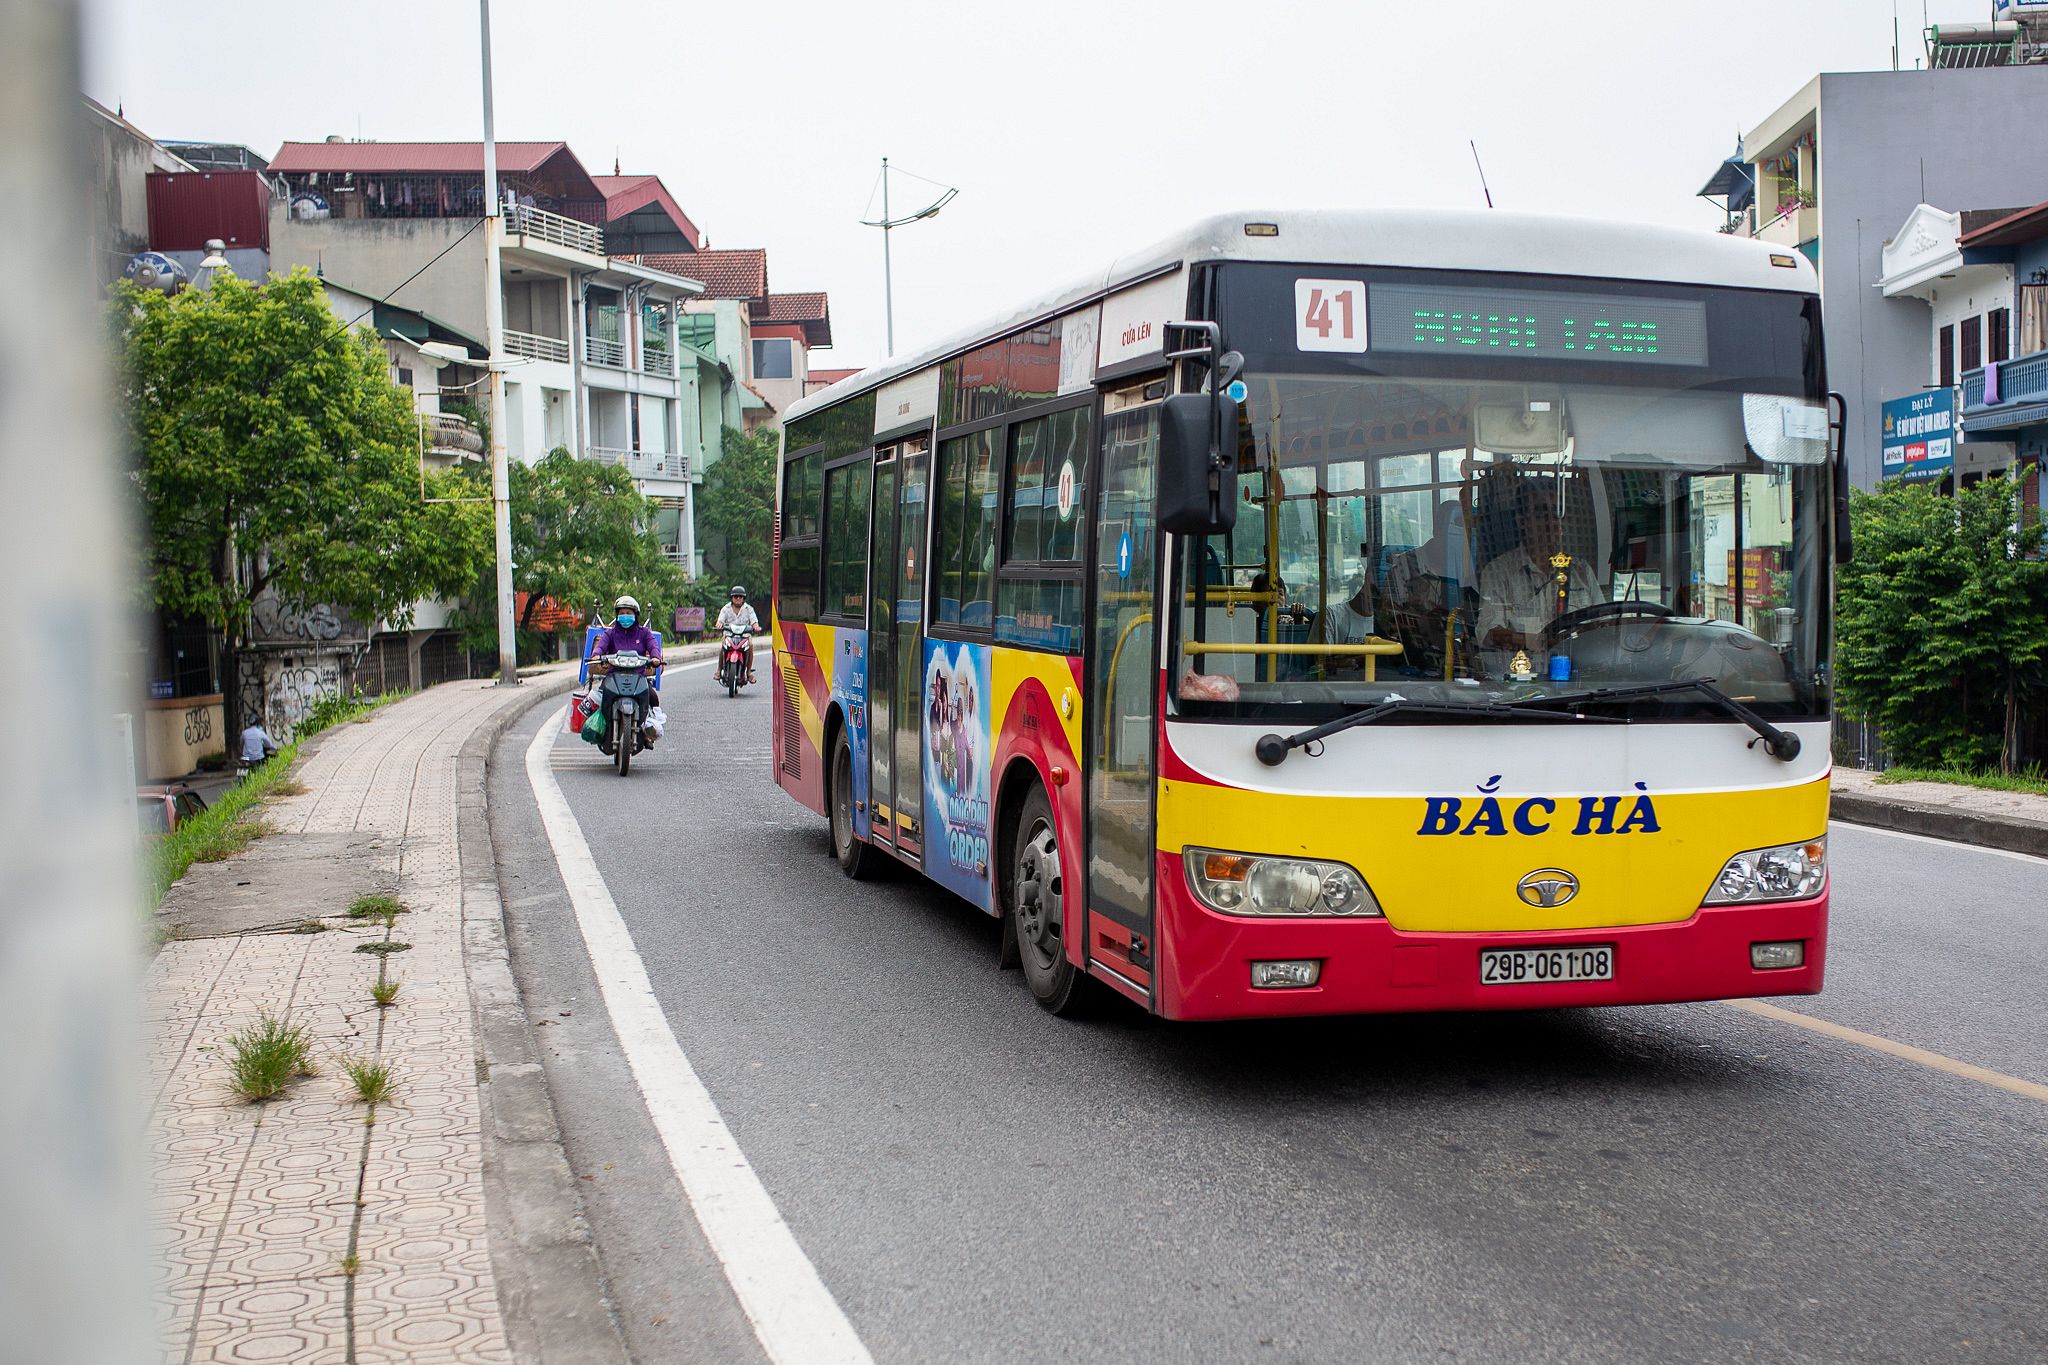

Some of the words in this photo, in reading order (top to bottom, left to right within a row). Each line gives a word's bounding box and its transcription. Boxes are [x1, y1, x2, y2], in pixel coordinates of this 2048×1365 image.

[1137, 321, 1152, 341] LÊN
[1306, 289, 1353, 338] 41
[1060, 474, 1071, 508] 41
[1417, 775, 1555, 835] BẮC
[1571, 782, 1661, 835] HÀ
